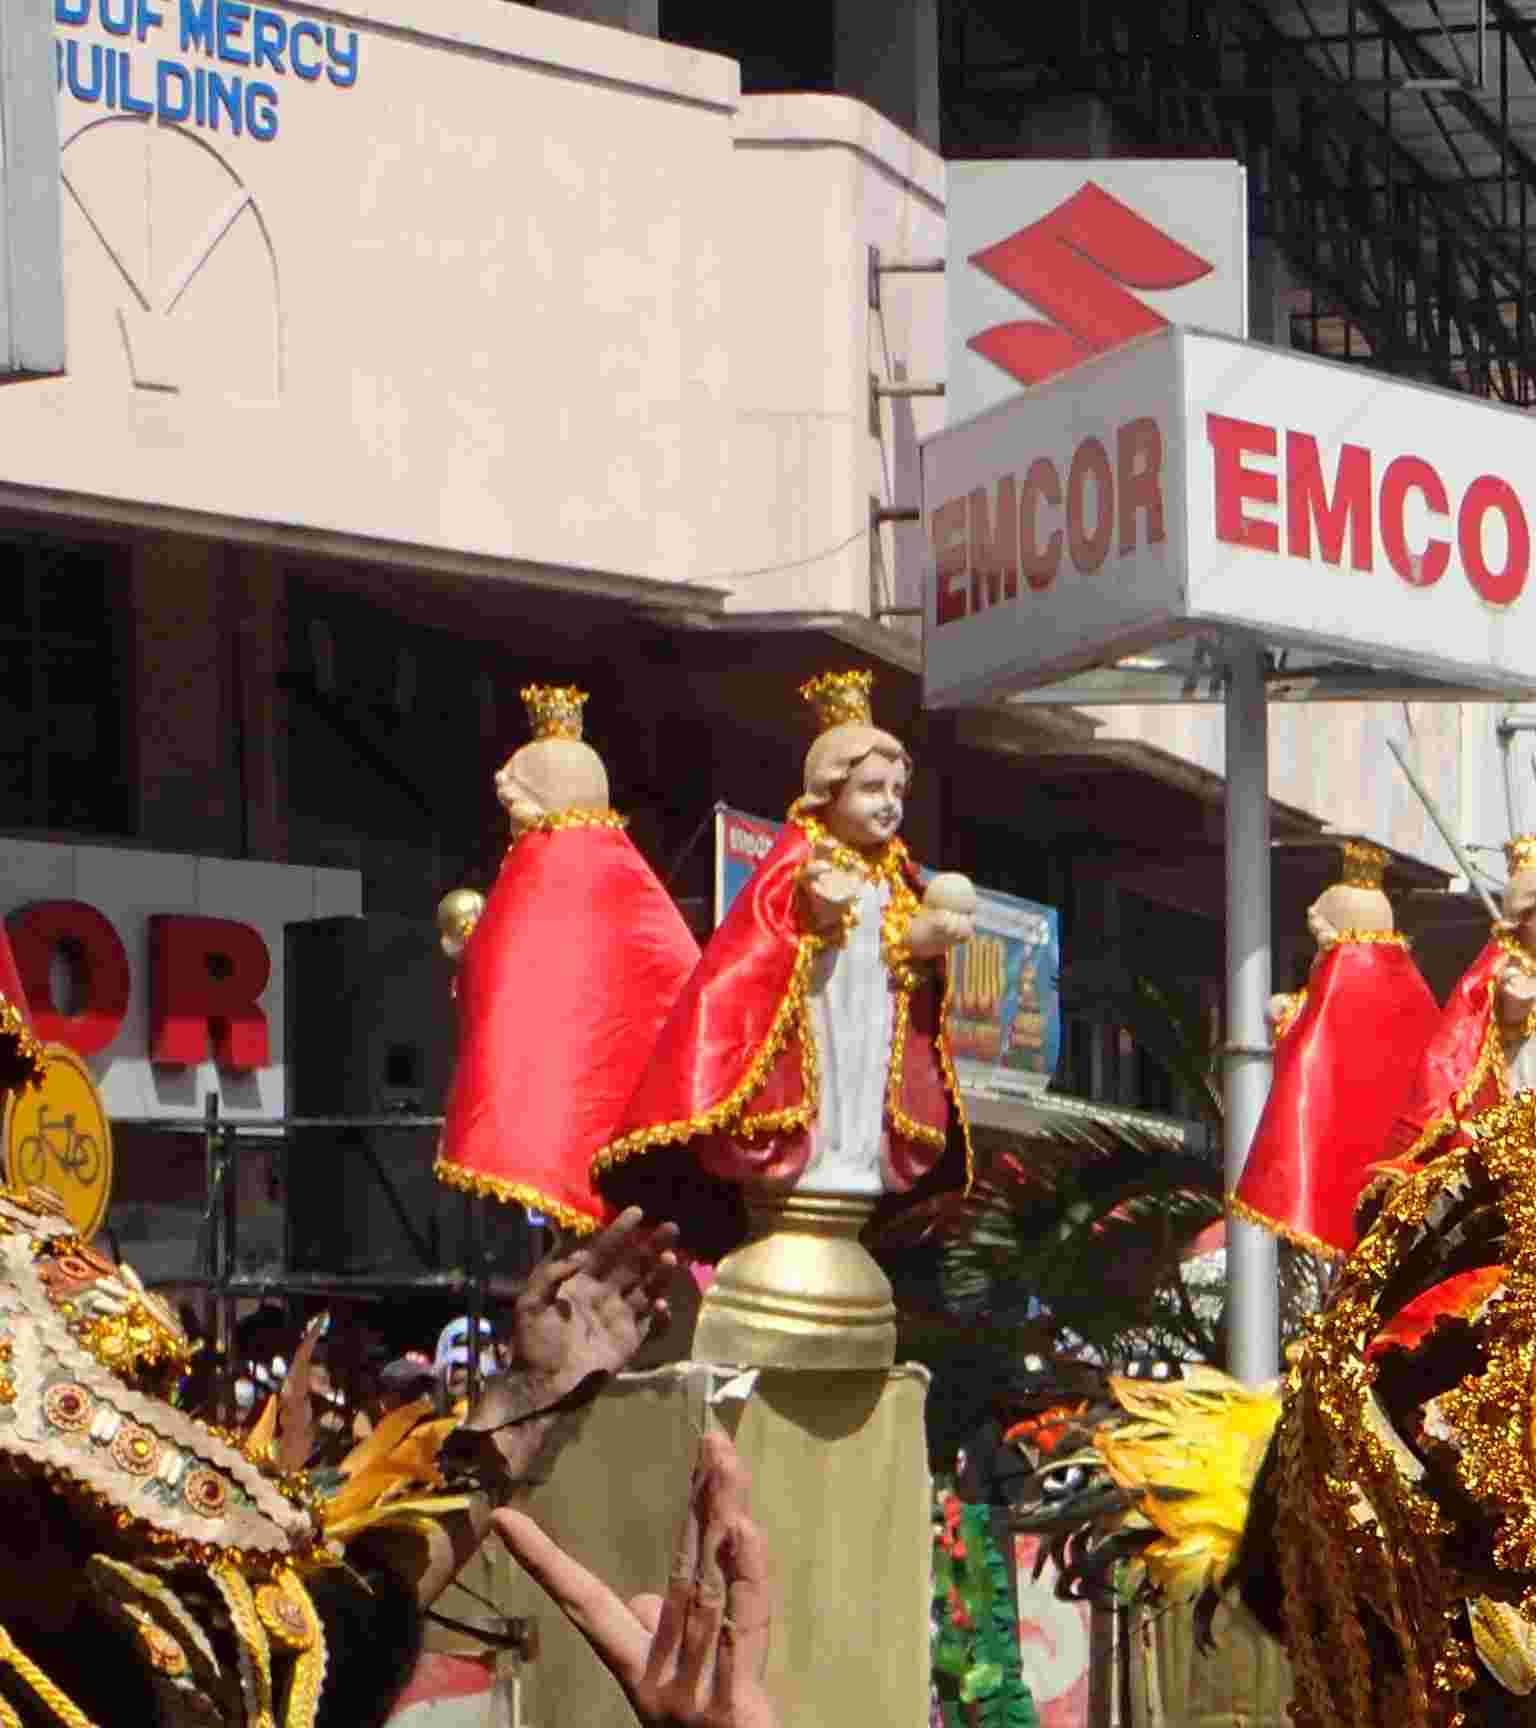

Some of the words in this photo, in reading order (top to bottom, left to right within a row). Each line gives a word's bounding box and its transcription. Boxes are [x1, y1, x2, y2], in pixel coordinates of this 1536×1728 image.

[57, 38, 279, 141] UILDING
[180, 0, 358, 88] MERCY
[929, 416, 1166, 627] EMCOR
